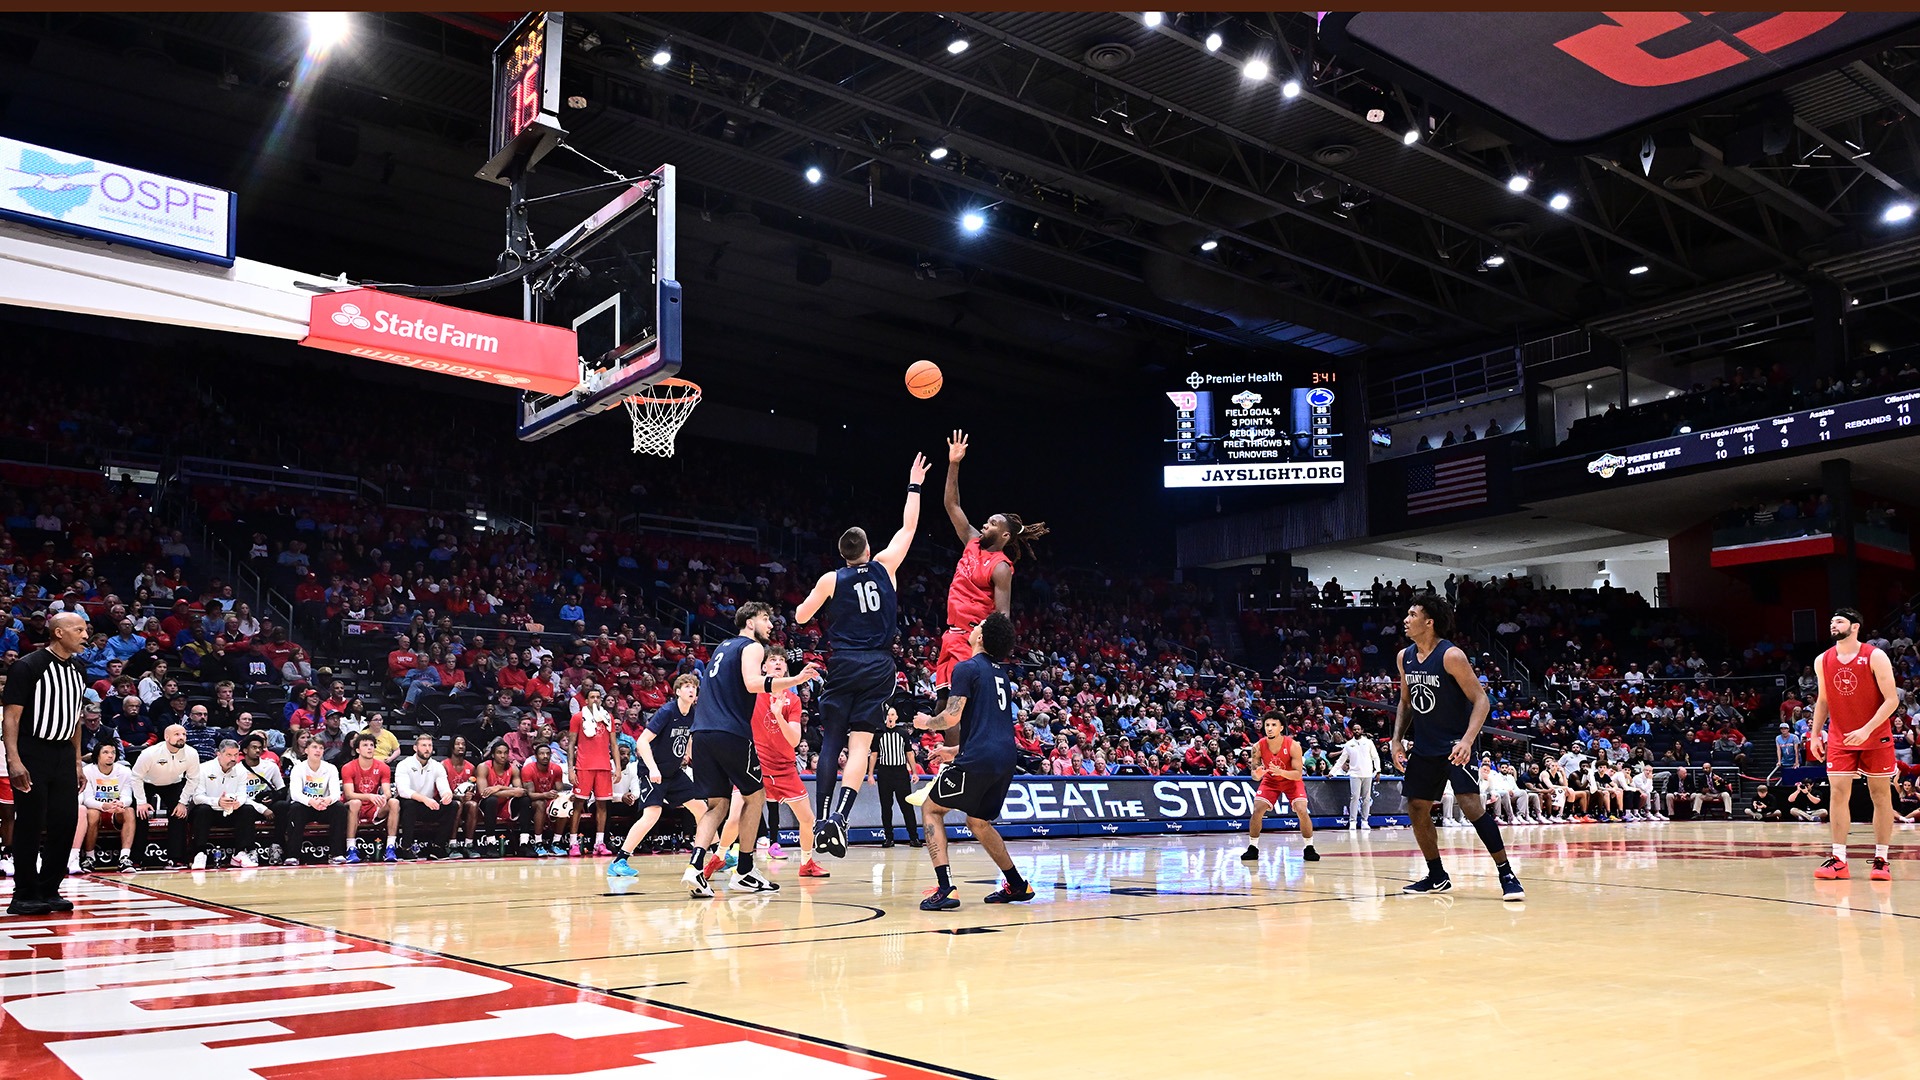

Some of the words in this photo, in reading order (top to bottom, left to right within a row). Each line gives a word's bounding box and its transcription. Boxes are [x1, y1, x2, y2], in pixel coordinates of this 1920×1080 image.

[100, 172, 216, 221] OSPF
[1206, 373, 1246, 384] Premier
[1247, 371, 1283, 383] Health
[1312, 372, 1337, 384] 3:41
[1225, 409, 1248, 417] FIELD
[1249, 408, 1272, 416] GOAL
[1272, 407, 1281, 416] %
[1897, 403, 1910, 413] 11
[1809, 408, 1835, 419] Assists
[1231, 418, 1238, 426] 3
[1239, 418, 1264, 426] POINT
[1264, 417, 1273, 425] %
[1819, 418, 1828, 427] 5
[1844, 414, 1892, 429] REBOUNDS
[1896, 415, 1912, 426] 10
[1229, 429, 1276, 438] REBOUNDS
[1711, 430, 1729, 438] Made
[1780, 425, 1788, 434] 4
[1743, 432, 1754, 442] 11
[1819, 430, 1831, 441] 11
[1223, 440, 1244, 448] FREE
[1247, 439, 1282, 448] THROWS
[1716, 438, 1724, 447] 6
[1781, 438, 1789, 447] 9
[1227, 450, 1278, 459] TURNOVERS
[1715, 449, 1728, 459] 10
[1742, 445, 1755, 455] 15
[1627, 453, 1651, 464] PENN
[1652, 447, 1681, 459] STATE
[1627, 461, 1666, 475] DAYTON
[1201, 466, 1342, 483] JAYSLIGHT.ORG
[853, 580, 881, 613] 16
[709, 653, 724, 678] 3
[994, 676, 1007, 711] 5
[1000, 783, 1109, 820] BEAT
[1105, 800, 1145, 817] THE
